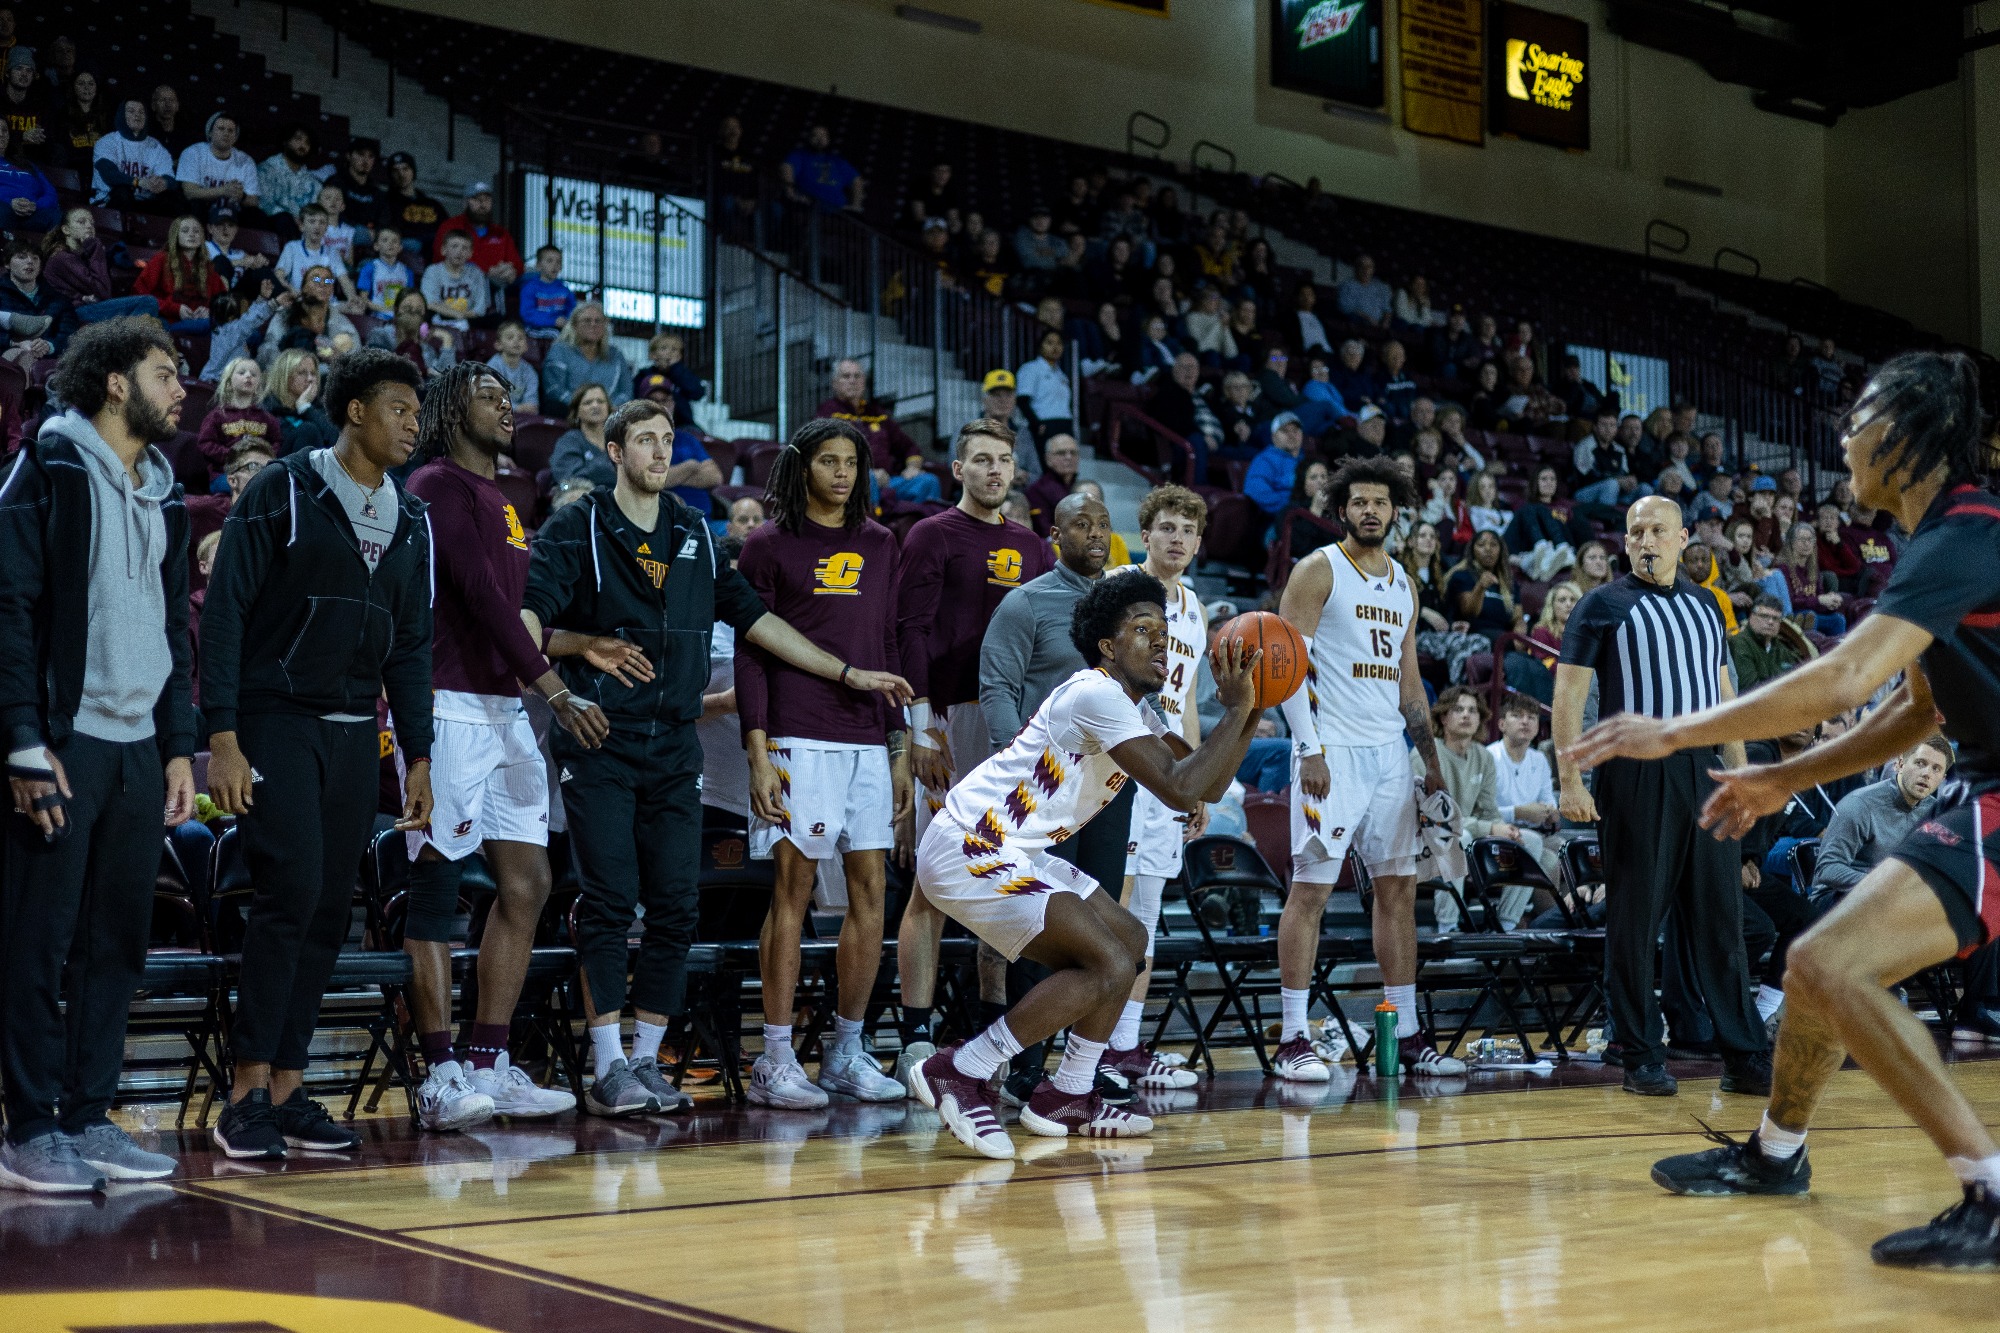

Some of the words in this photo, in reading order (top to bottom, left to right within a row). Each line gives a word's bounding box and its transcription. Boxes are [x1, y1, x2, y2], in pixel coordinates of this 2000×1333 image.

[1526, 43, 1584, 83] Soaring
[1531, 69, 1574, 100] Eagle
[1356, 604, 1403, 627] CENTRAL
[1168, 634, 1195, 659] TRAL
[1370, 628, 1393, 659] 15
[1166, 662, 1185, 693] 4
